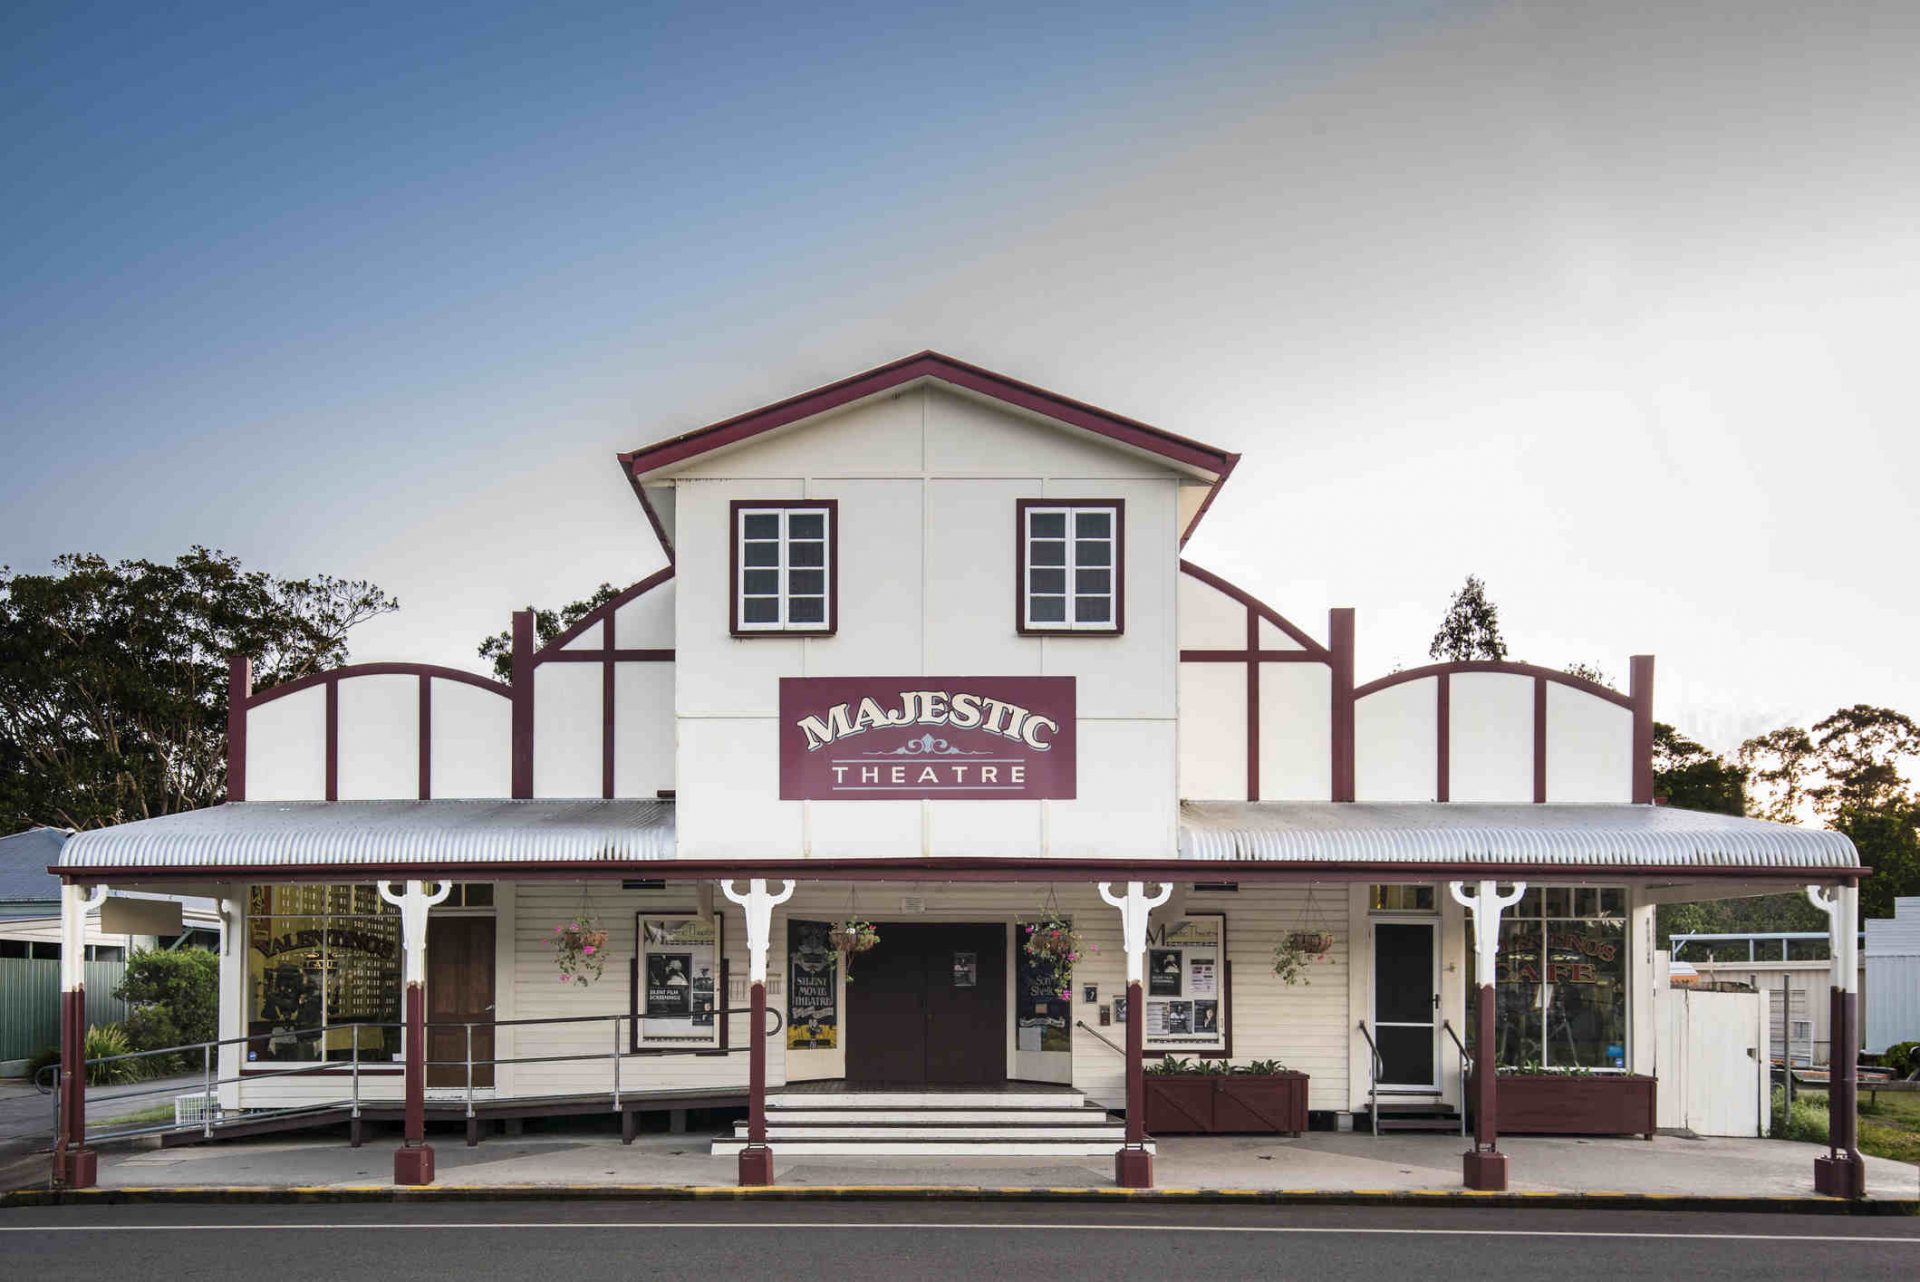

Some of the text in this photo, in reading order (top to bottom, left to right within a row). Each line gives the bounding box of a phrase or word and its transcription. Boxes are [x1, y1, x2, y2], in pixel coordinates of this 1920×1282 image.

[797, 690, 1058, 751] MAJESTIC
[832, 766, 1026, 783] THEATRE
[796, 976, 827, 986] SILENT
[798, 986, 827, 996] MOVIE
